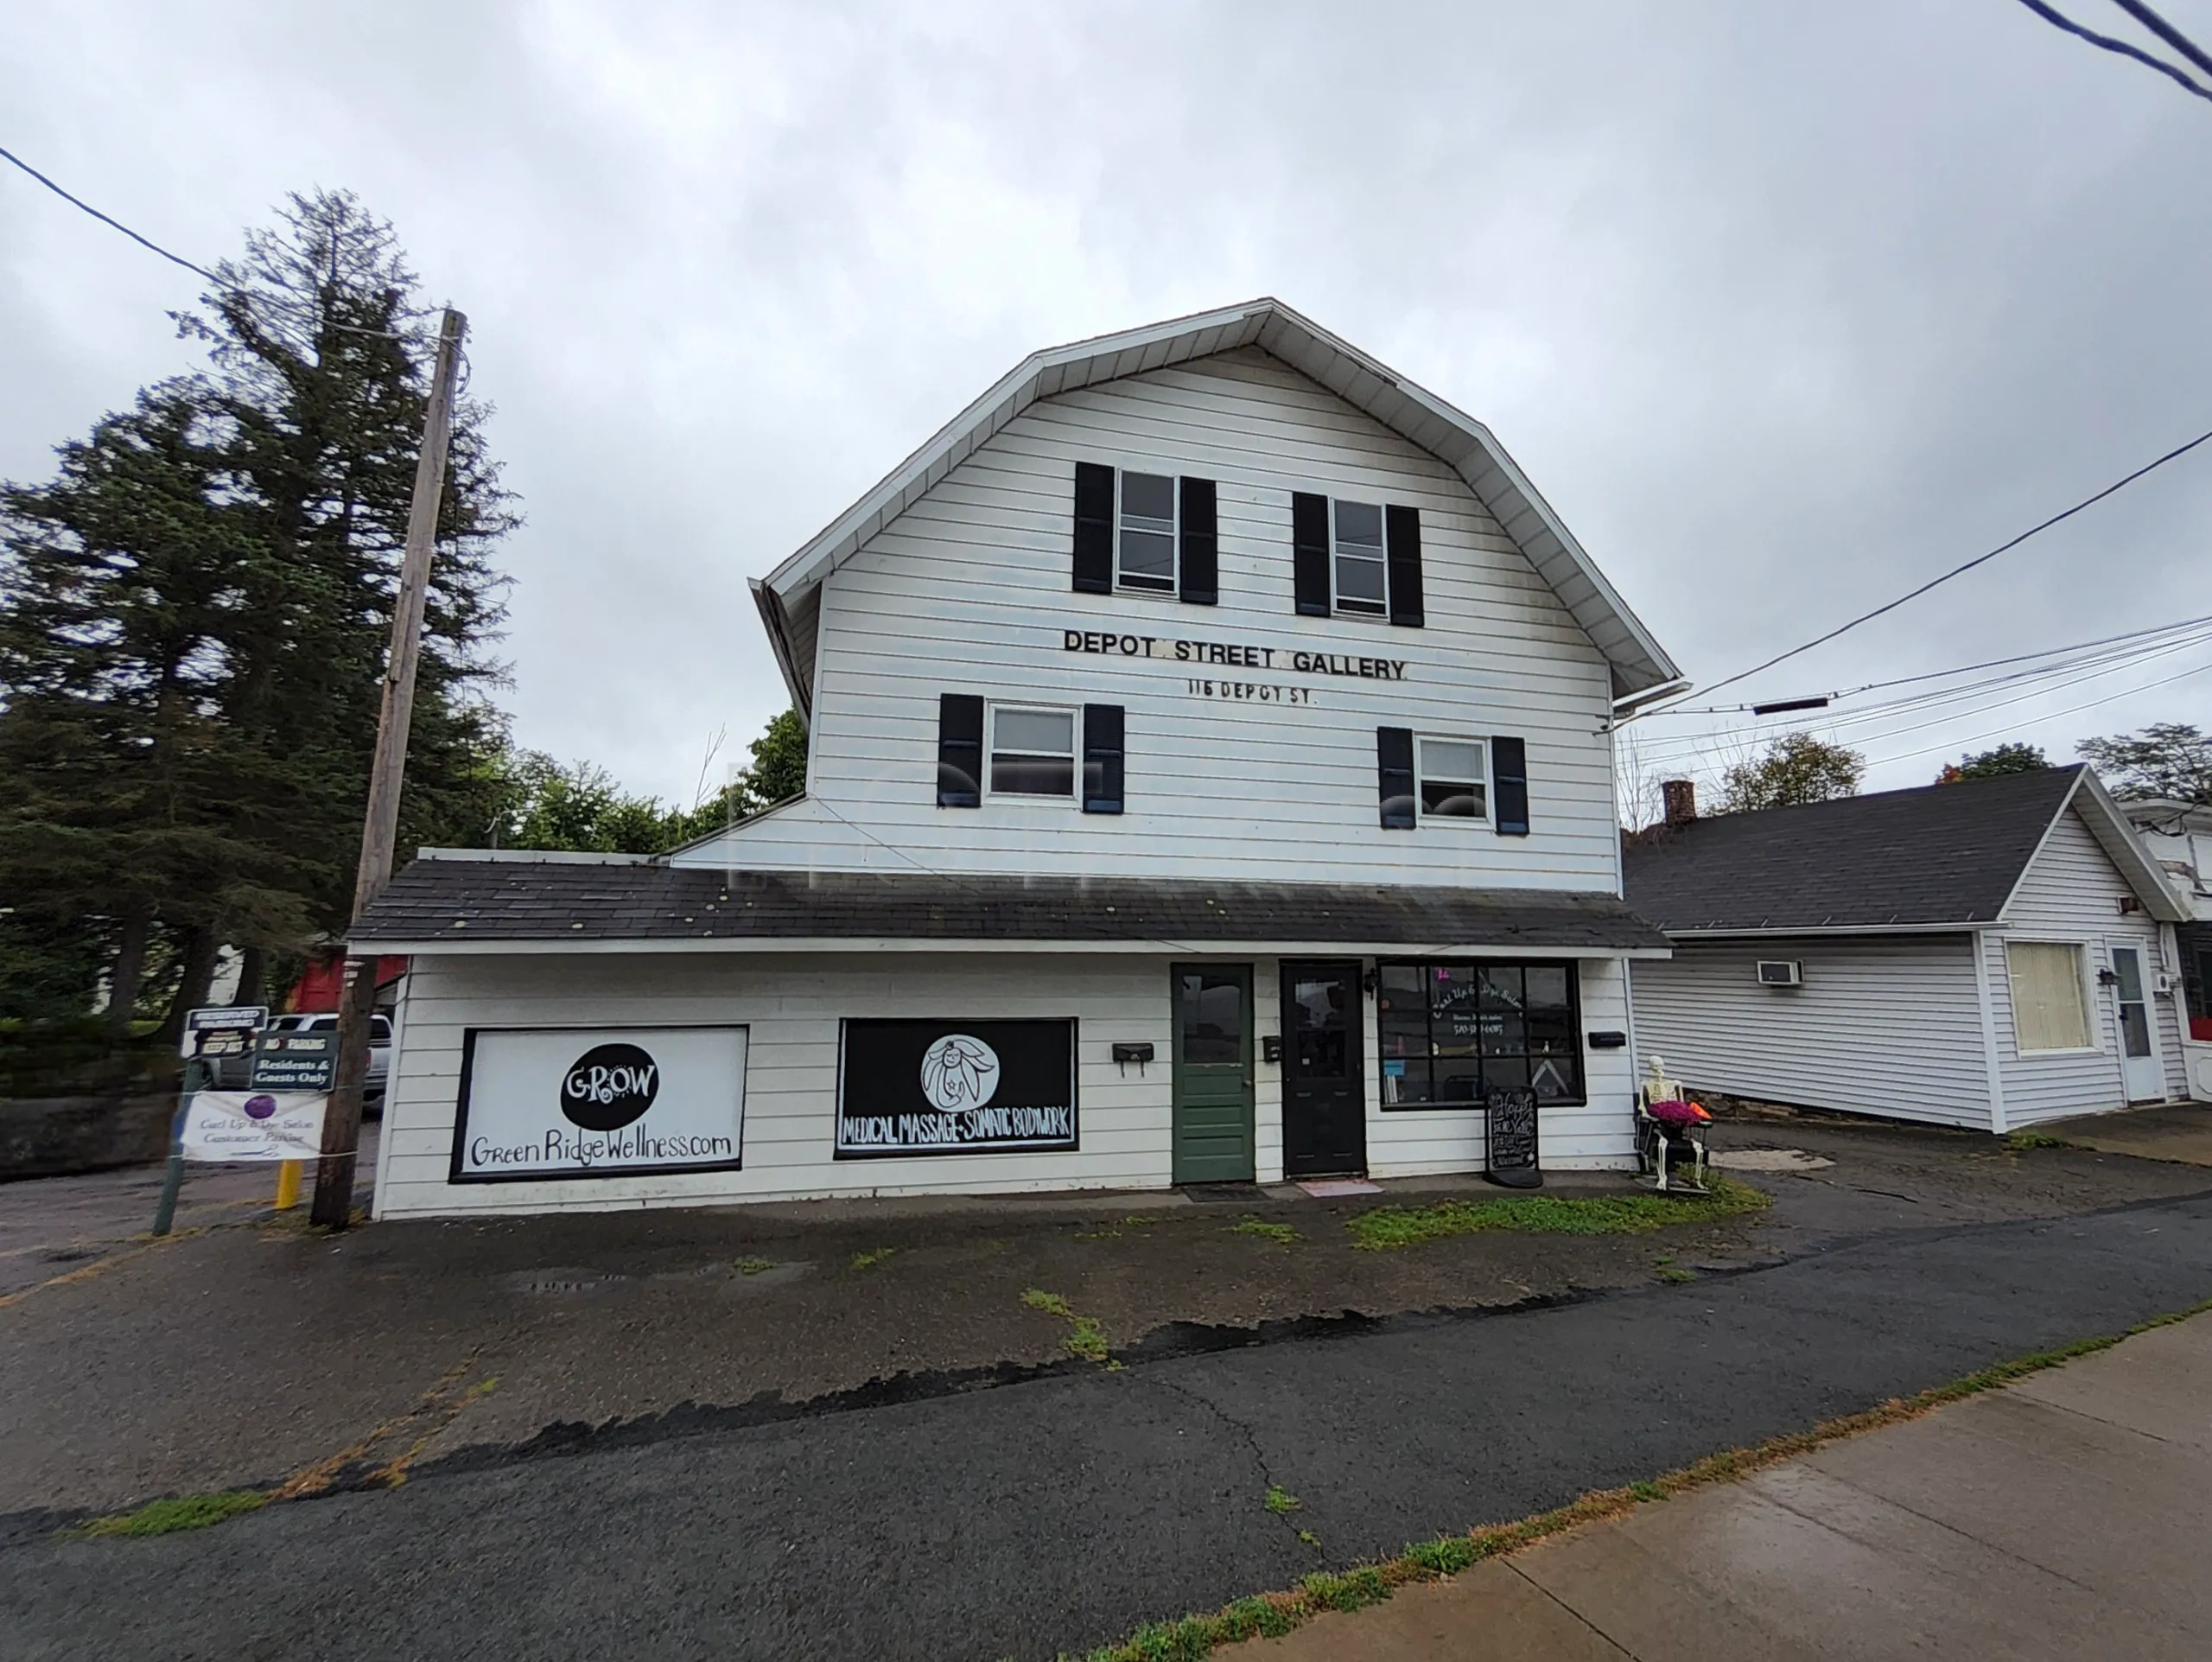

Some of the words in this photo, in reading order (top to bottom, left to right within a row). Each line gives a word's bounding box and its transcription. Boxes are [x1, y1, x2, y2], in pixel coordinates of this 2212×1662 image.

[1064, 629, 1156, 659] DEPOT
[1174, 640, 1276, 669] STREET
[1293, 652, 1407, 680] GALLERY
[1221, 681, 1282, 702] DEPOT
[255, 1073, 296, 1082] Guests
[298, 1073, 329, 1085] Only
[257, 1060, 315, 1070] Residents
[318, 1060, 330, 1070] &
[566, 1064, 656, 1105] GROW
[842, 1115, 898, 1144] MEDICAL
[1014, 1105, 1070, 1137] BODYWORK
